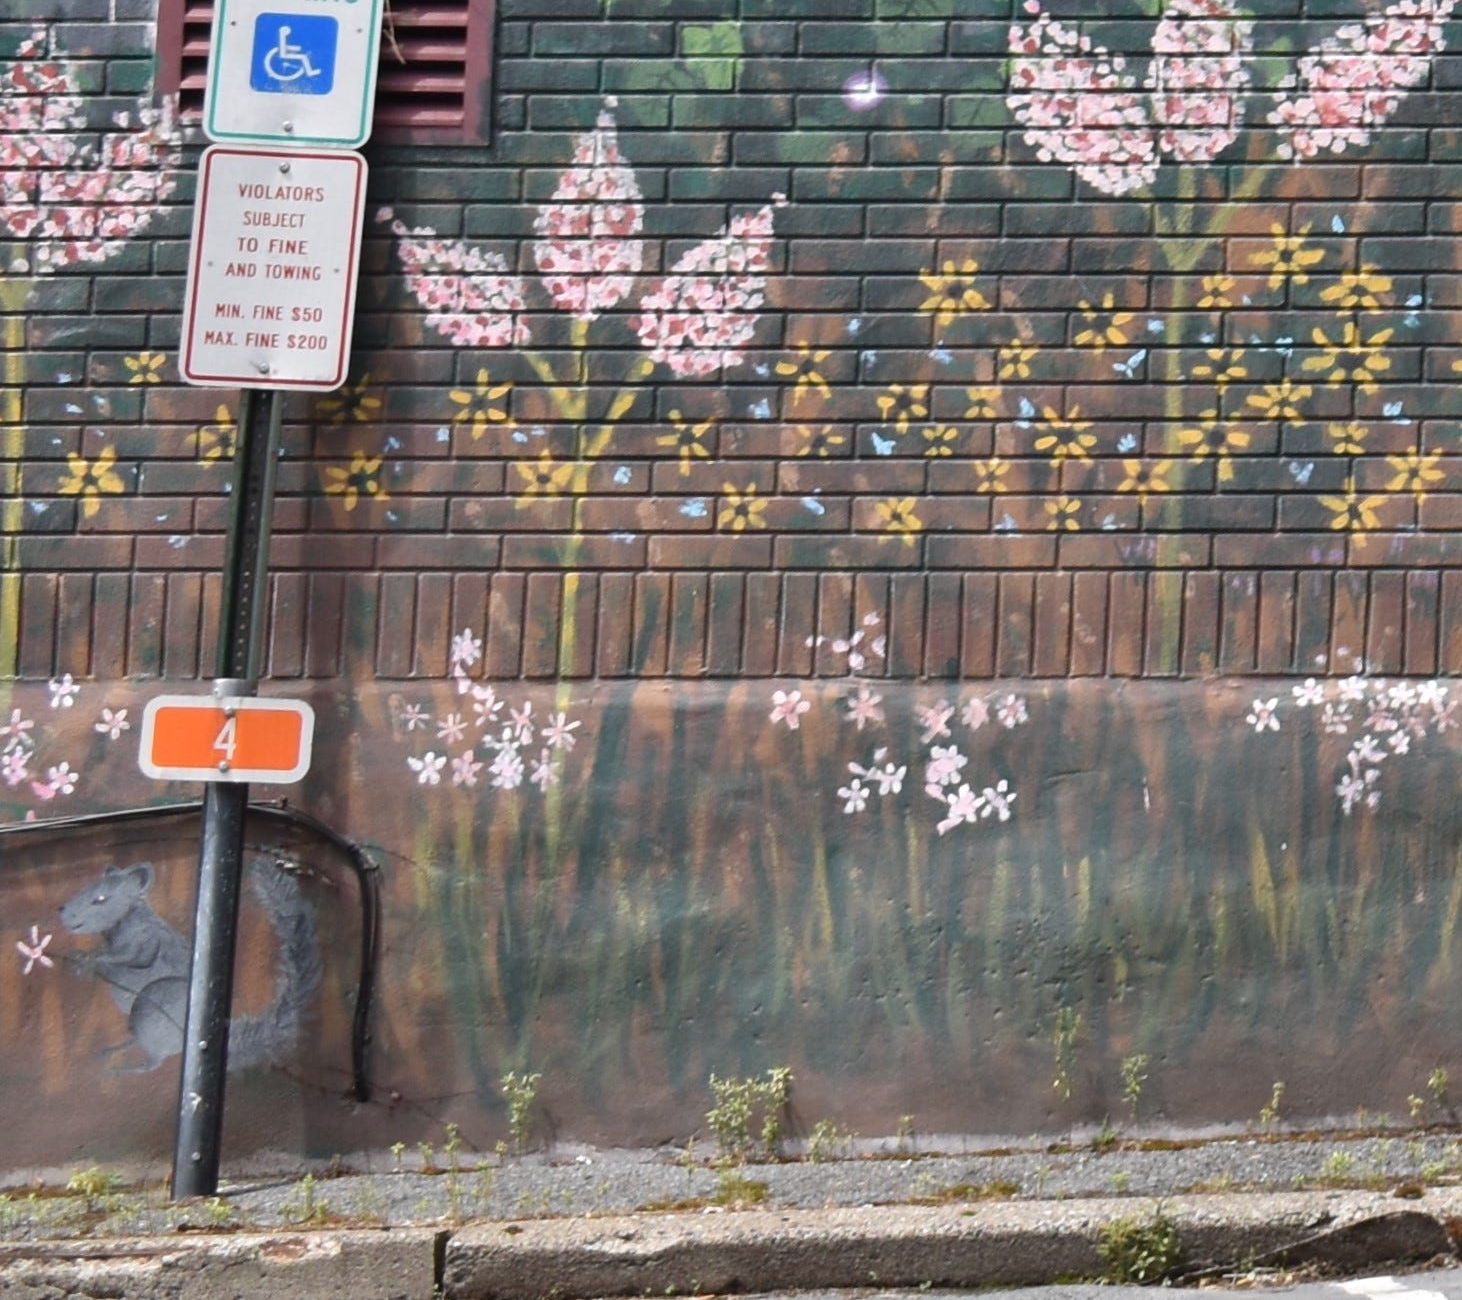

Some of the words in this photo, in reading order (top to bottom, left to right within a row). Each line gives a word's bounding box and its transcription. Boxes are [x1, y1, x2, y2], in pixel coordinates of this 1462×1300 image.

[239, 184, 323, 202] VIOLATORS
[243, 211, 304, 228] SUBJECT
[238, 238, 258, 252] TO
[269, 239, 306, 254] FINE
[226, 263, 256, 277] AND
[266, 265, 320, 280] TOWING
[216, 304, 245, 318] MIN.
[253, 305, 282, 320] FINE
[292, 307, 322, 322] $50
[205, 331, 238, 346] MAX.
[246, 333, 278, 347] FINE
[287, 335, 327, 350] $200
[213, 716, 236, 761] 4
